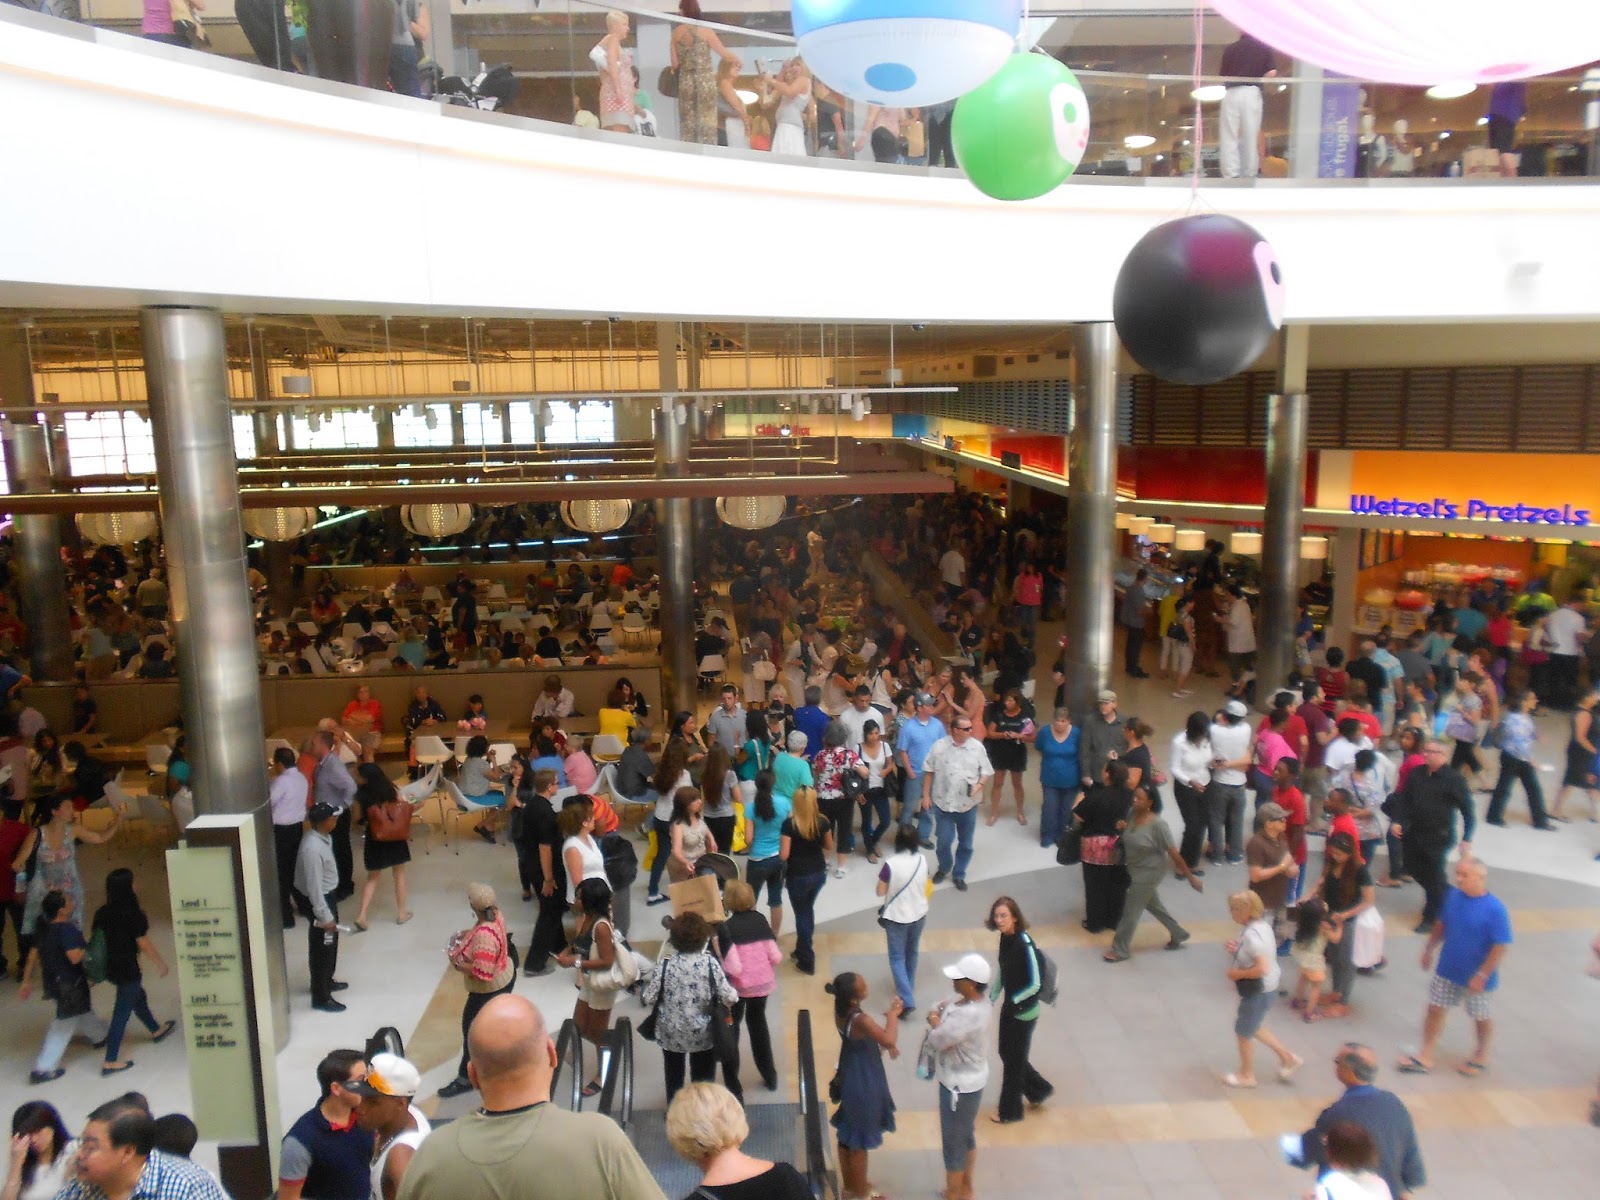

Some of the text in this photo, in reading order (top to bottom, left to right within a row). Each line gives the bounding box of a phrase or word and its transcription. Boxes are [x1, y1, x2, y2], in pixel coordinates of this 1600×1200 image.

[1351, 495, 1591, 526] Wetzel's Pretzels
[181, 899, 200, 908] Level
[191, 994, 209, 1003] Level
